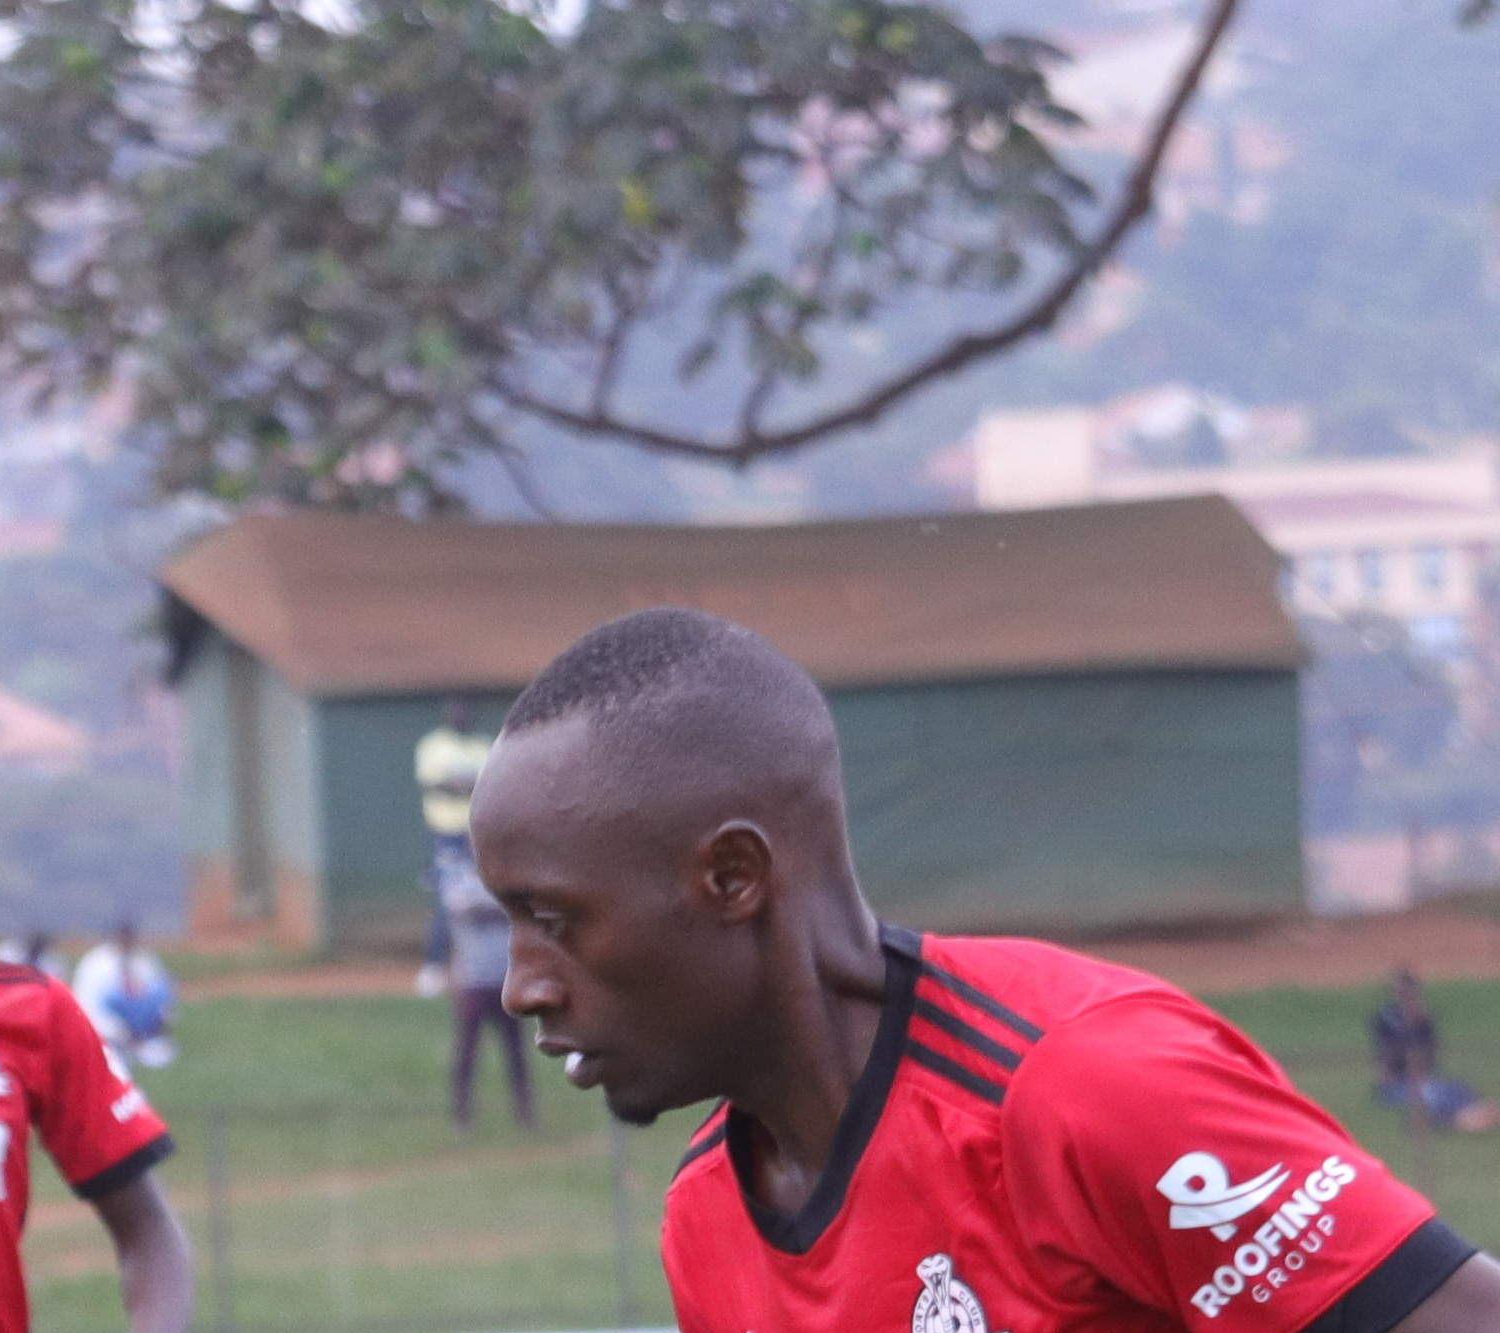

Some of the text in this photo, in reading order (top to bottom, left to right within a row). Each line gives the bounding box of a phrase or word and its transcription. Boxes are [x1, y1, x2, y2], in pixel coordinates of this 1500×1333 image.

[1190, 1155, 1356, 1318] ROOFINGS
[1251, 1213, 1336, 1303] GROUP
[958, 1290, 981, 1327] CLUB
